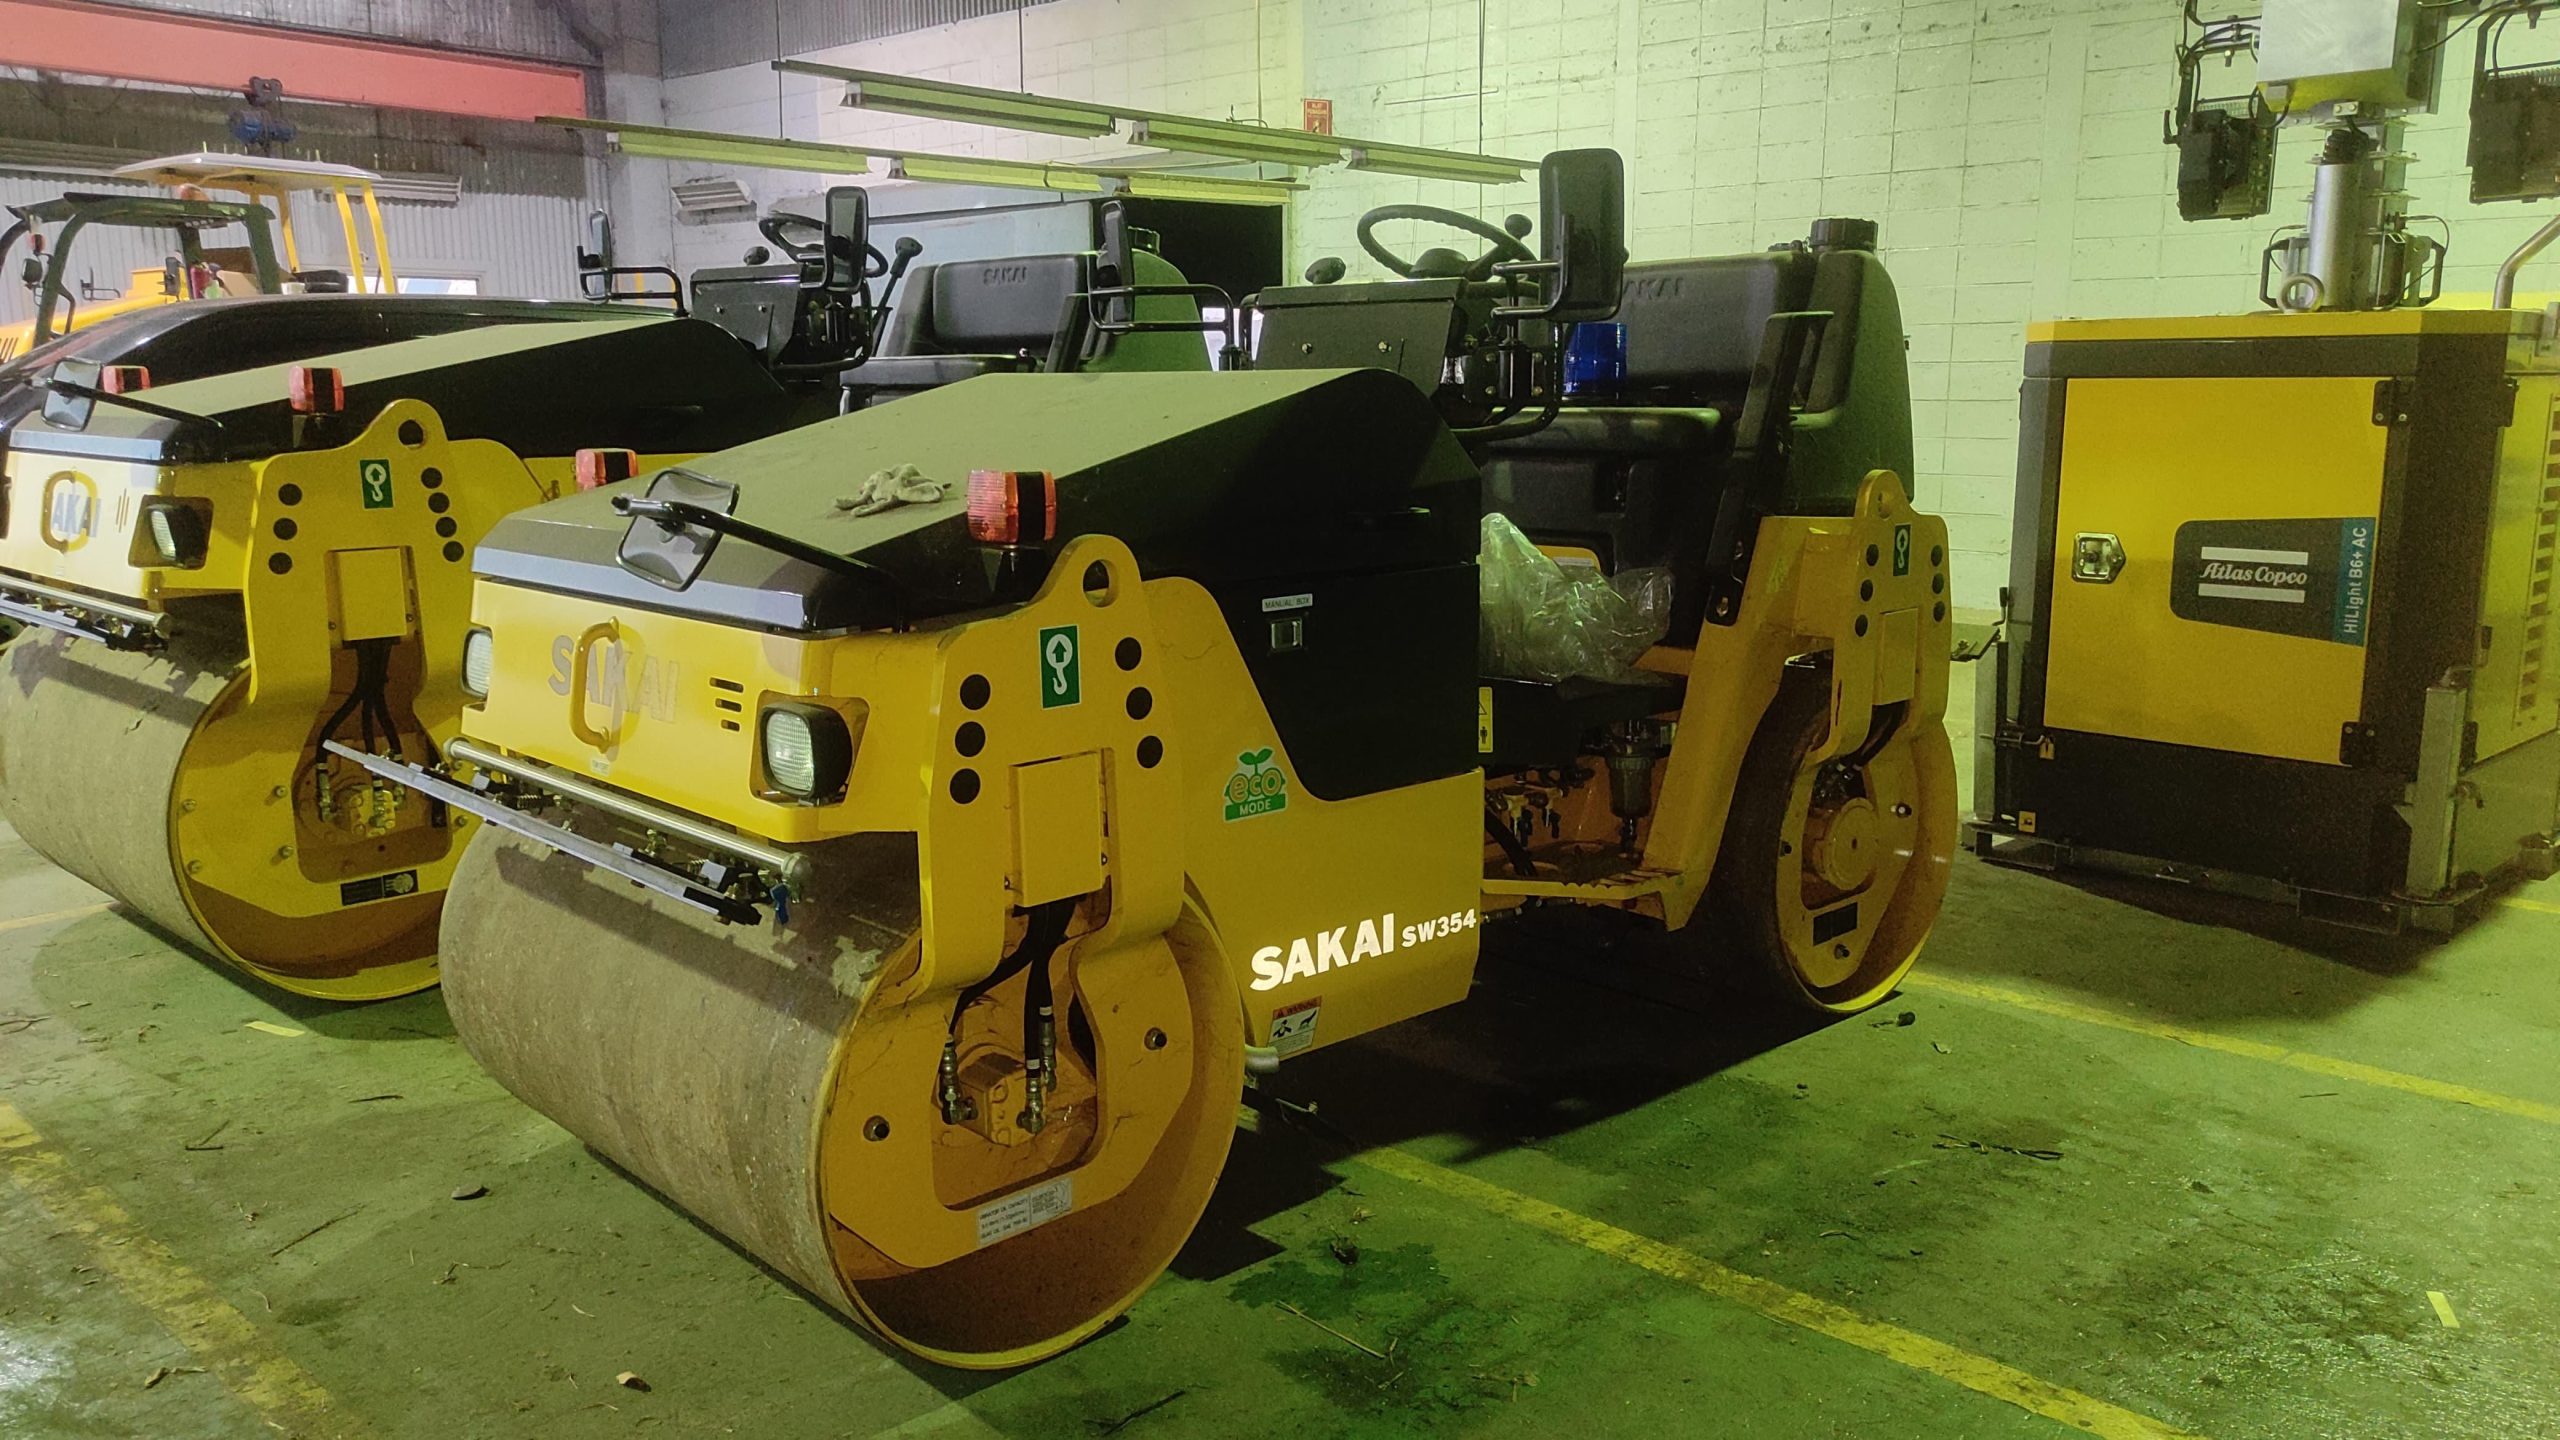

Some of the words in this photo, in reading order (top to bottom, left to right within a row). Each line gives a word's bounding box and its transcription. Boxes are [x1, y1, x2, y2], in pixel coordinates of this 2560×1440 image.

[1622, 276, 1684, 300] AKAI
[46, 491, 101, 538] AKAI
[2351, 527, 2367, 548] AC
[2200, 562, 2253, 581] Atlas
[2255, 566, 2308, 587] Copco
[2348, 551, 2364, 579] B6+
[1264, 598, 1294, 609] MANUAL
[1296, 597, 1310, 606] BOX
[2343, 581, 2365, 634] HiLight
[1228, 767, 1283, 804] eco
[1240, 799, 1272, 816] MODE
[1250, 912, 1395, 991] SAKAI
[1401, 908, 1477, 948] SW354
